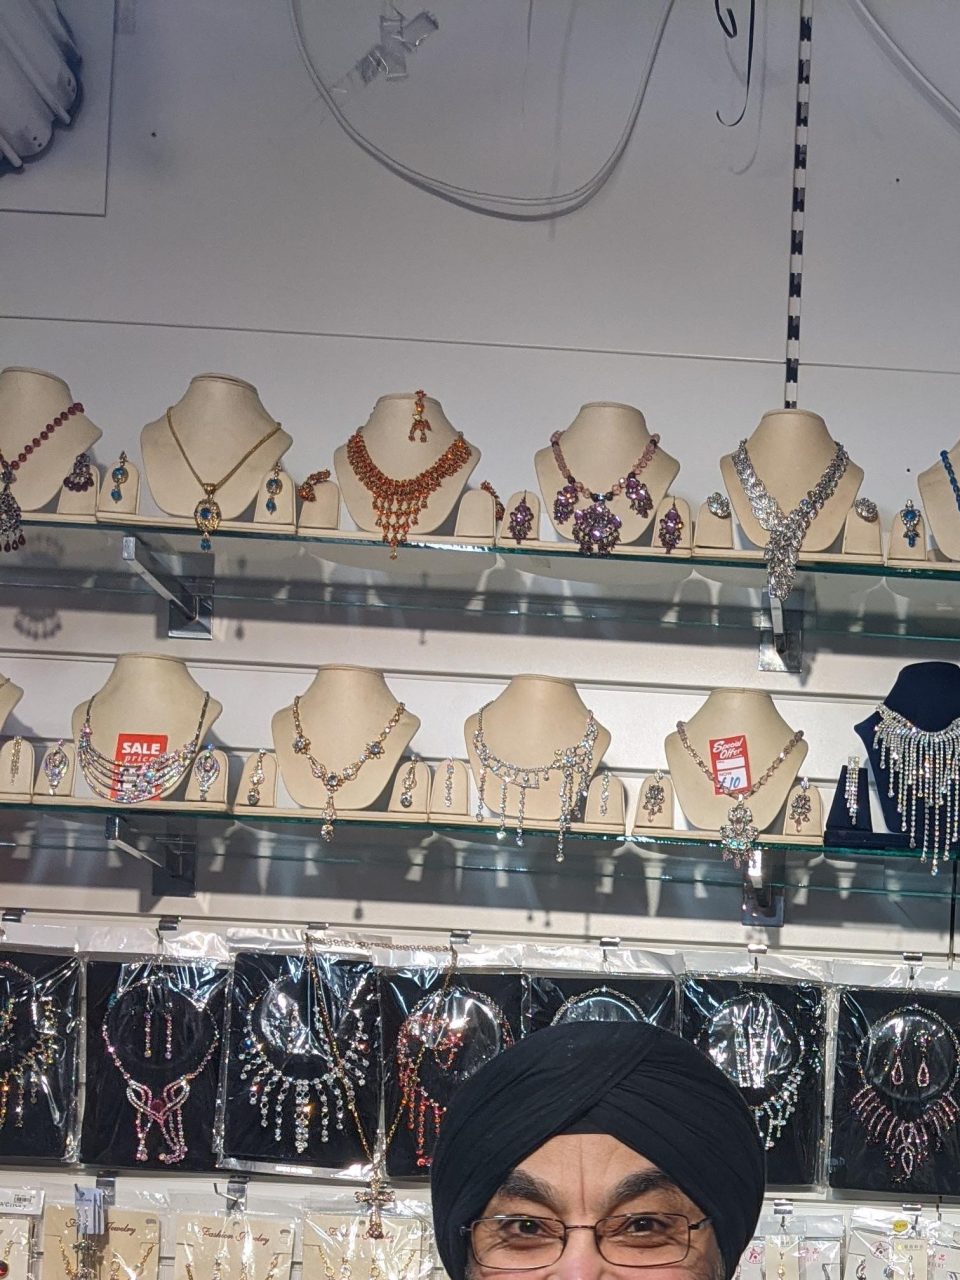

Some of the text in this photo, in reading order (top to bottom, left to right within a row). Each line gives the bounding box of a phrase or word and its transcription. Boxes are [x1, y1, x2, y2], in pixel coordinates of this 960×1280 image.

[121, 742, 161, 755] SALE
[713, 737, 744, 754] Special
[720, 748, 743, 759] Offer
[201, 1226, 233, 1240] Fashion
